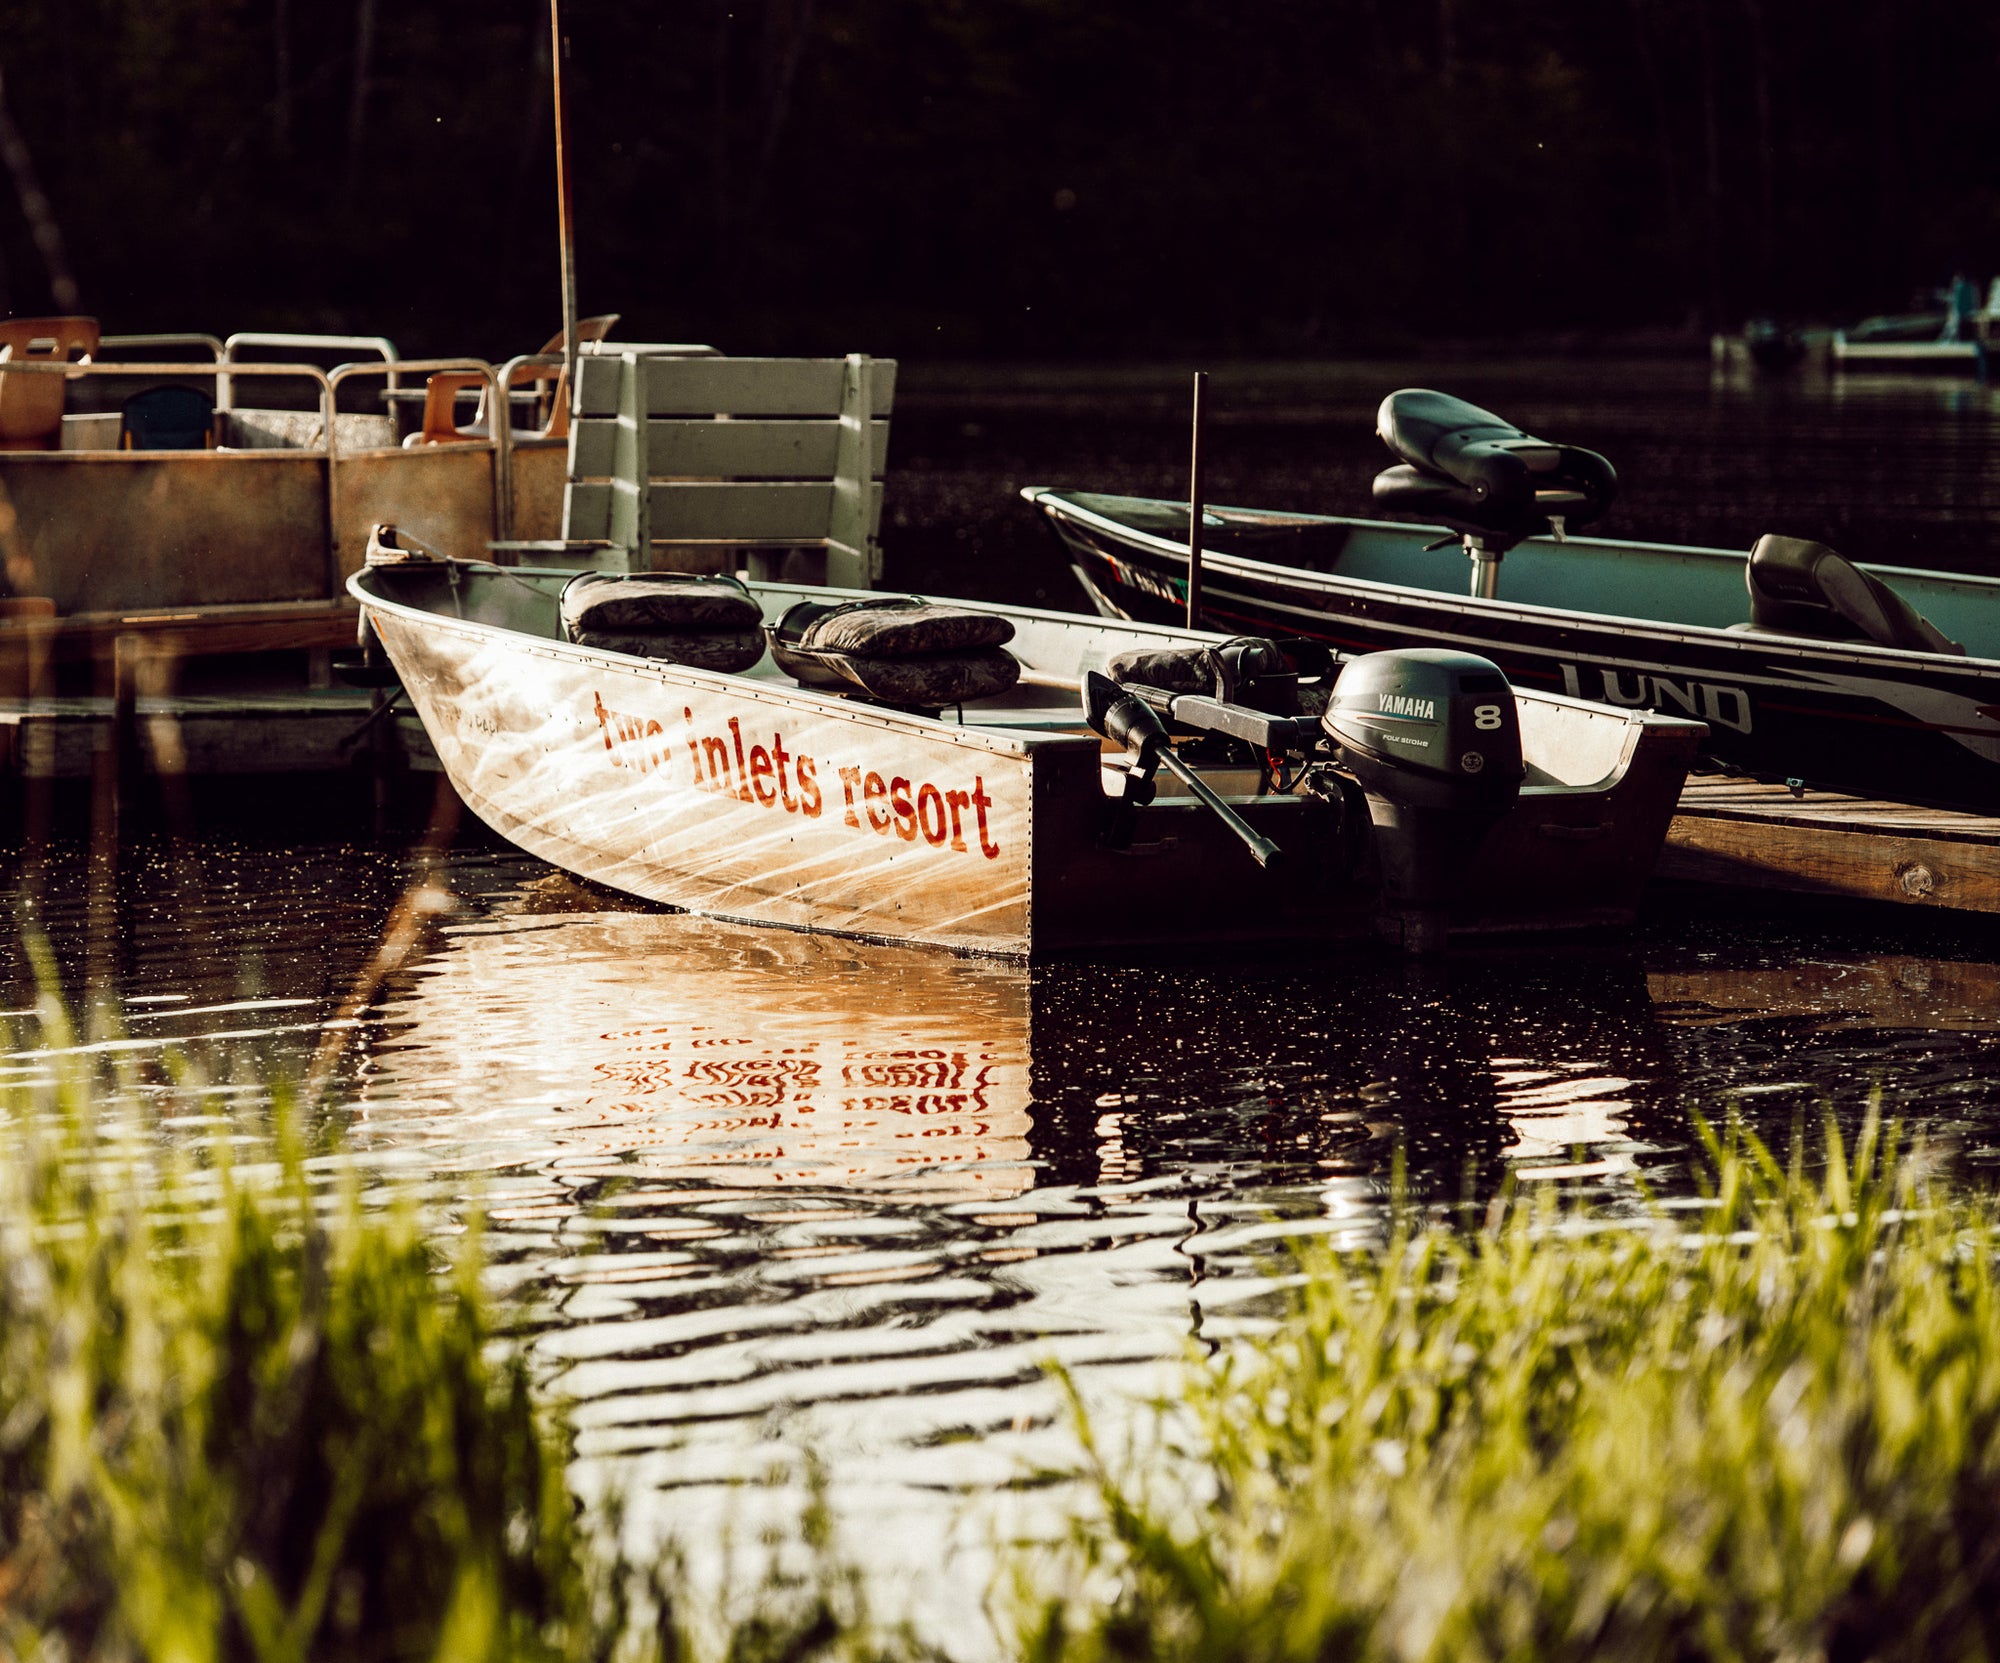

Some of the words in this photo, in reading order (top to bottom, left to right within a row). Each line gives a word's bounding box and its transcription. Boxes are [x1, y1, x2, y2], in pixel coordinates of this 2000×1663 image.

[1379, 694, 1435, 719] YAMAHA
[1474, 705, 1502, 730] 8
[1559, 663, 1752, 735] LUND
[684, 706, 822, 818] inlets
[838, 767, 1000, 860] resort
